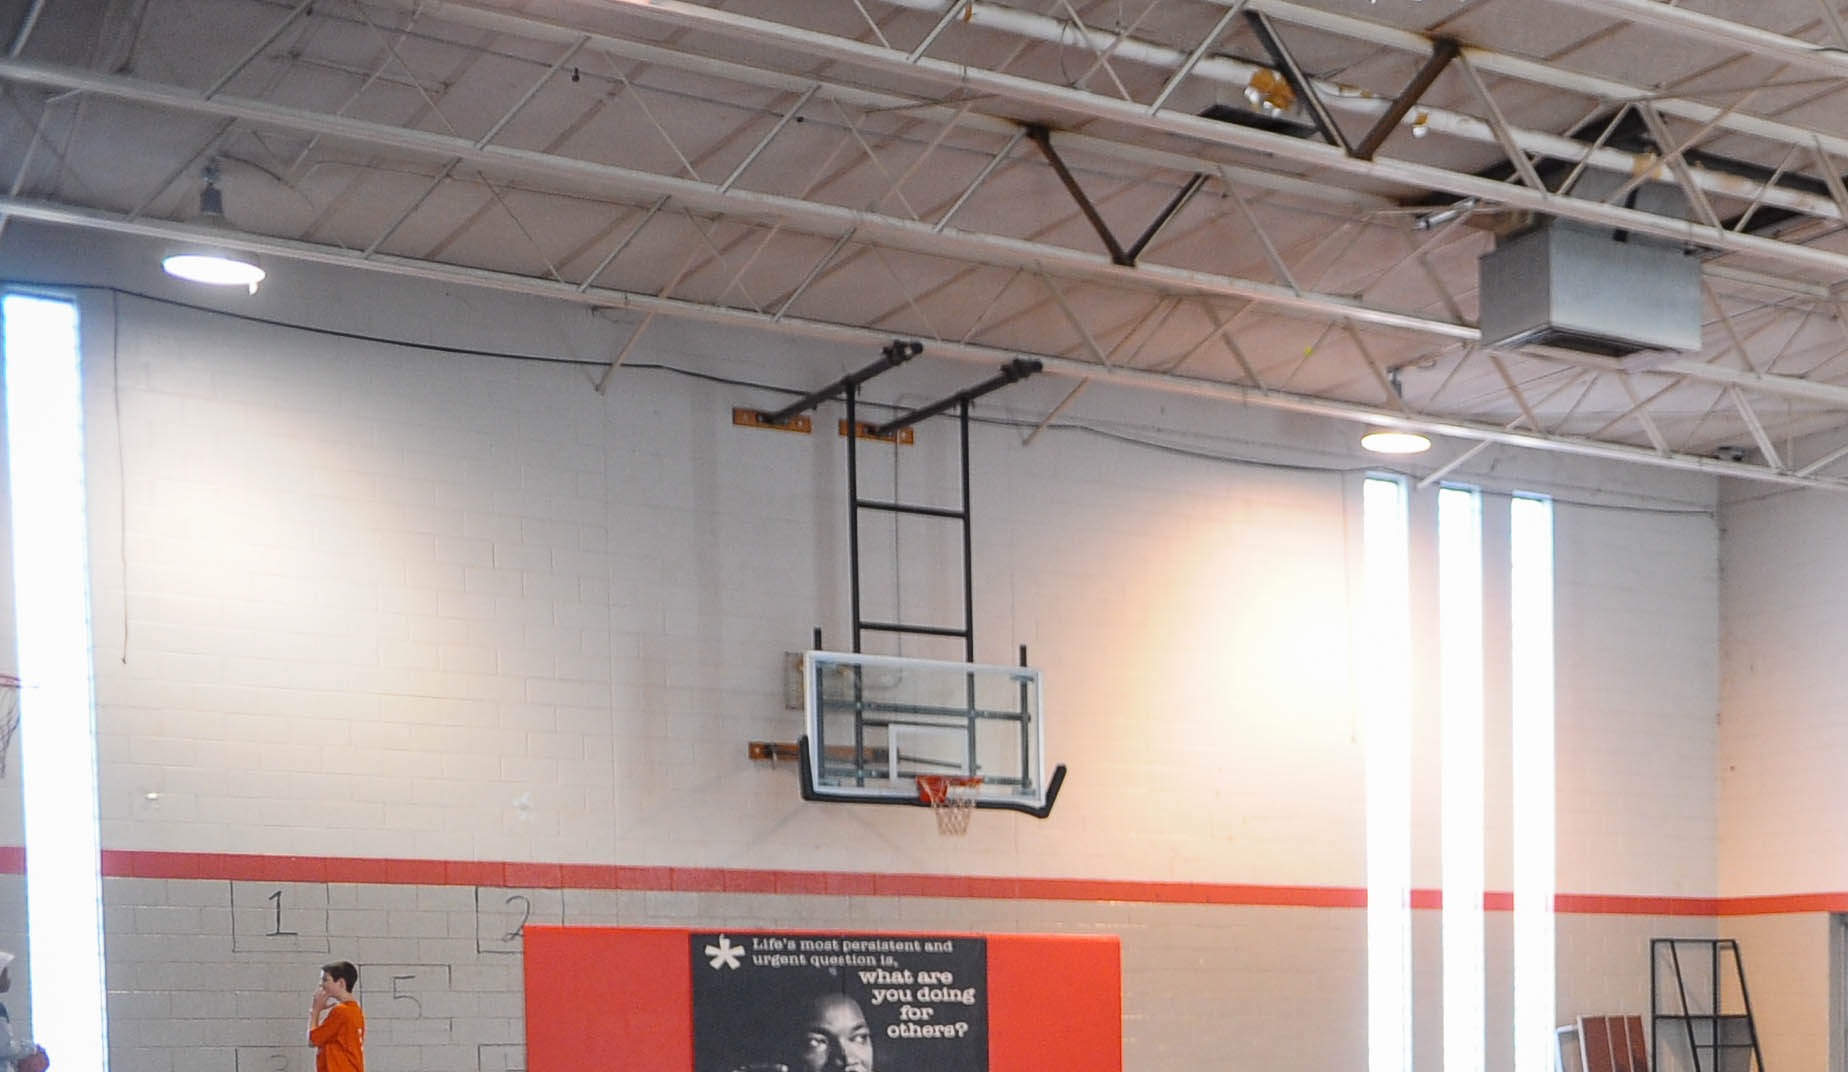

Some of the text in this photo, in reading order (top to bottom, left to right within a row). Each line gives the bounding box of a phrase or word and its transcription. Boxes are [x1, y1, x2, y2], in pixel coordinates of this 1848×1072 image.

[266, 890, 297, 936] 1
[502, 895, 530, 942] 2
[752, 938, 952, 954] Life's most persistent and
[752, 953, 898, 968] urgent question is,
[858, 968, 953, 985] what are
[393, 975, 422, 1021] 5
[872, 986, 976, 1005] you doing
[900, 1003, 934, 1020] for
[886, 1021, 968, 1038] others?
